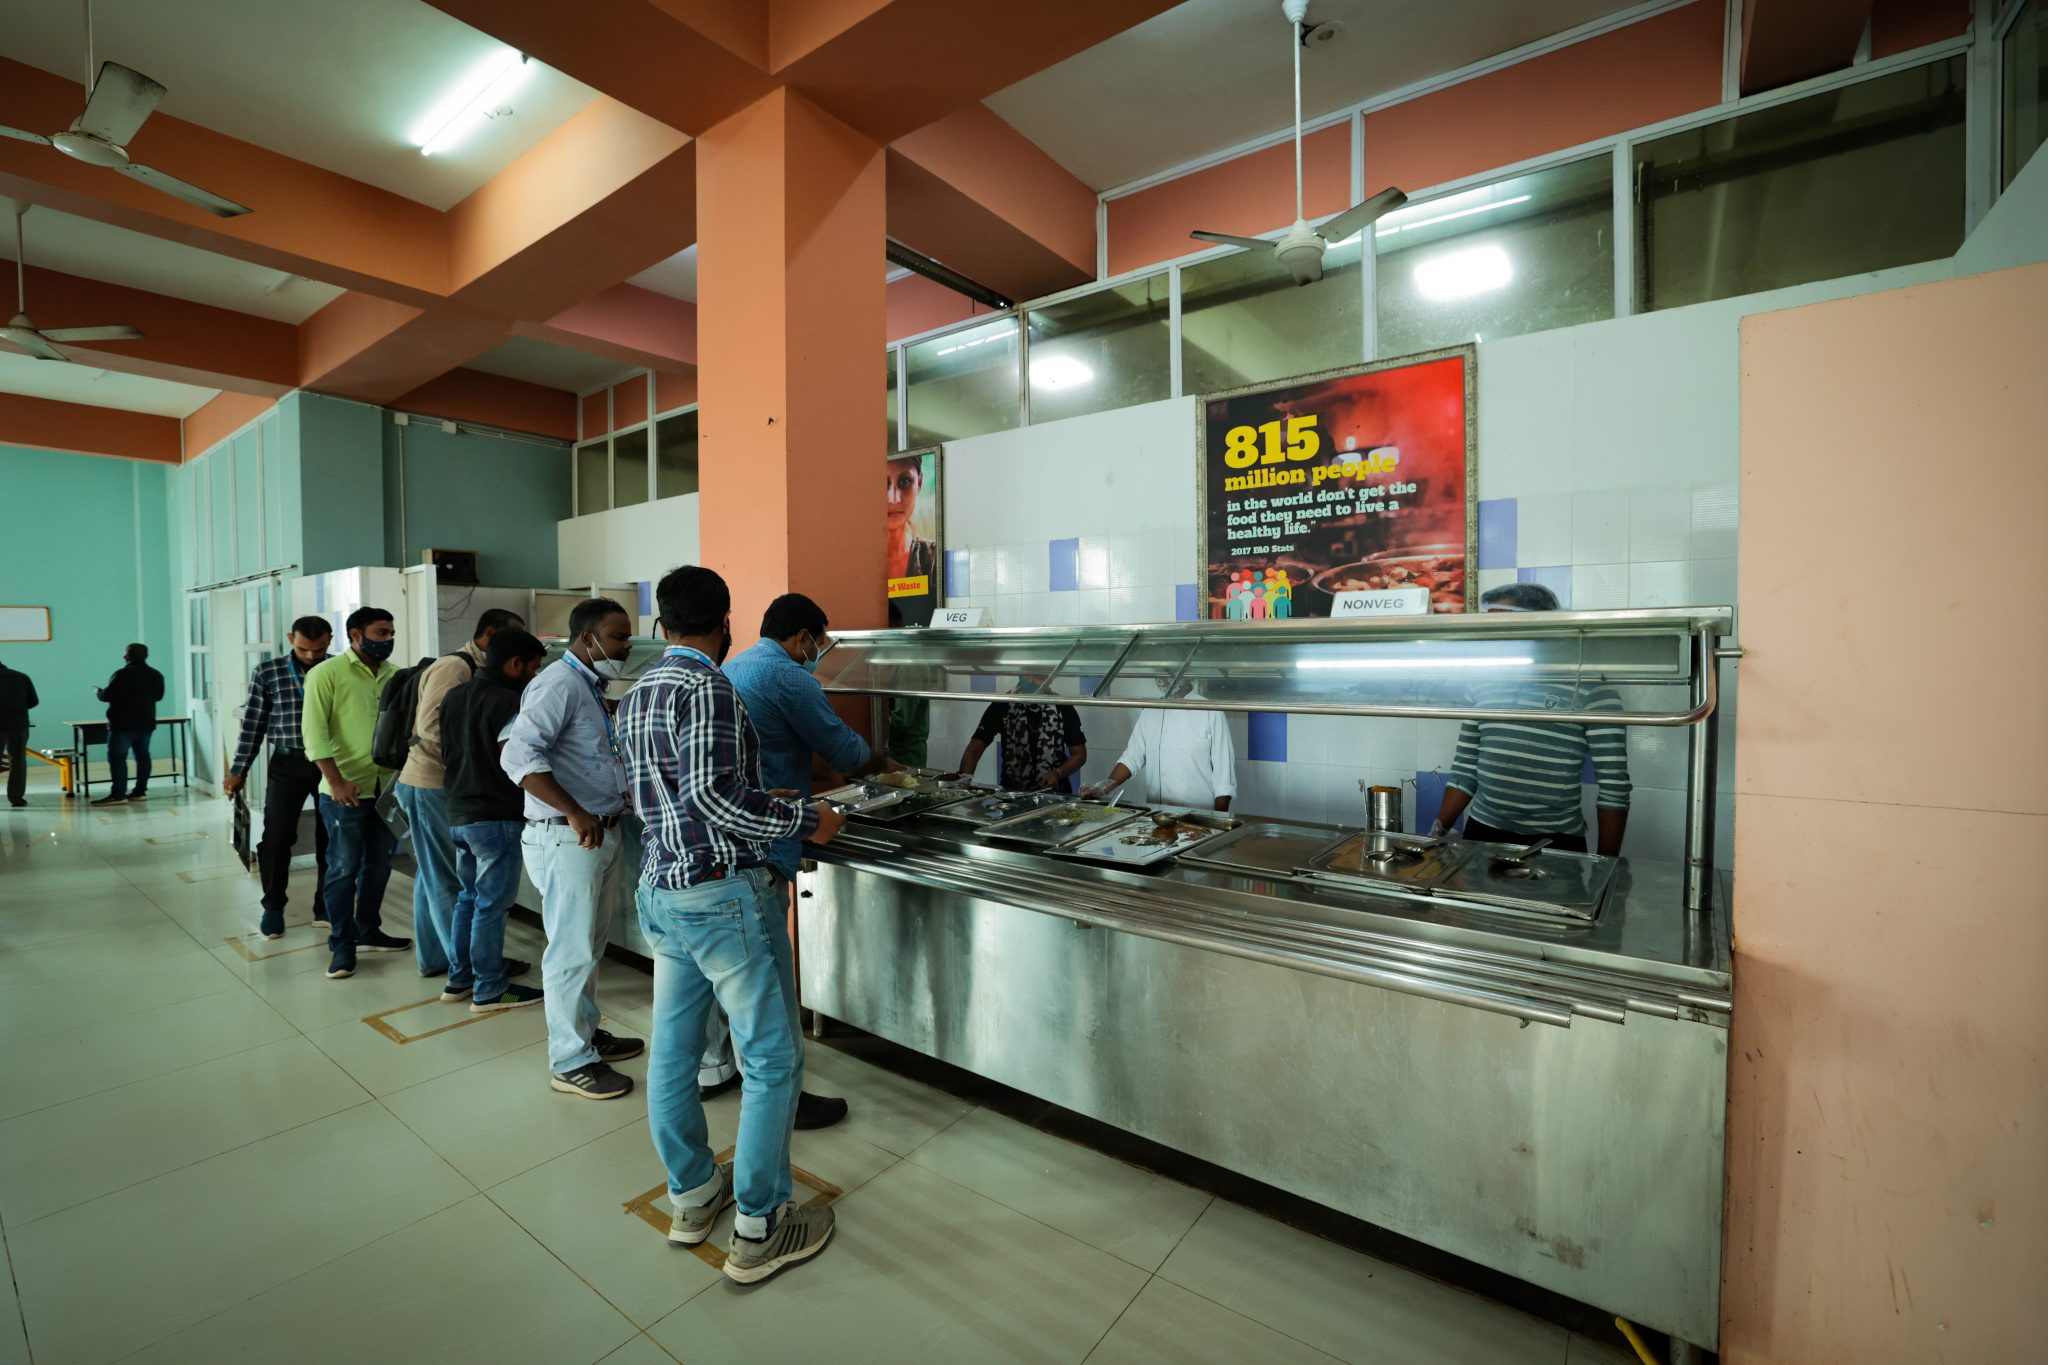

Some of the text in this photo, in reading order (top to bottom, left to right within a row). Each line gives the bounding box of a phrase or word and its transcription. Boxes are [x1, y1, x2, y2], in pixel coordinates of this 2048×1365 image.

[1225, 415, 1319, 468] 815
[1224, 455, 1396, 491] million people
[1227, 481, 1417, 512] in the world don't get the
[1227, 500, 1399, 526] food they need to live a
[1227, 526, 1281, 540] healthy
[1231, 547, 1252, 556] 2017
[1271, 544, 1294, 553] Stats
[897, 582, 921, 591] Waste
[1343, 598, 1404, 610] NONVEG
[946, 613, 967, 622] VEG
